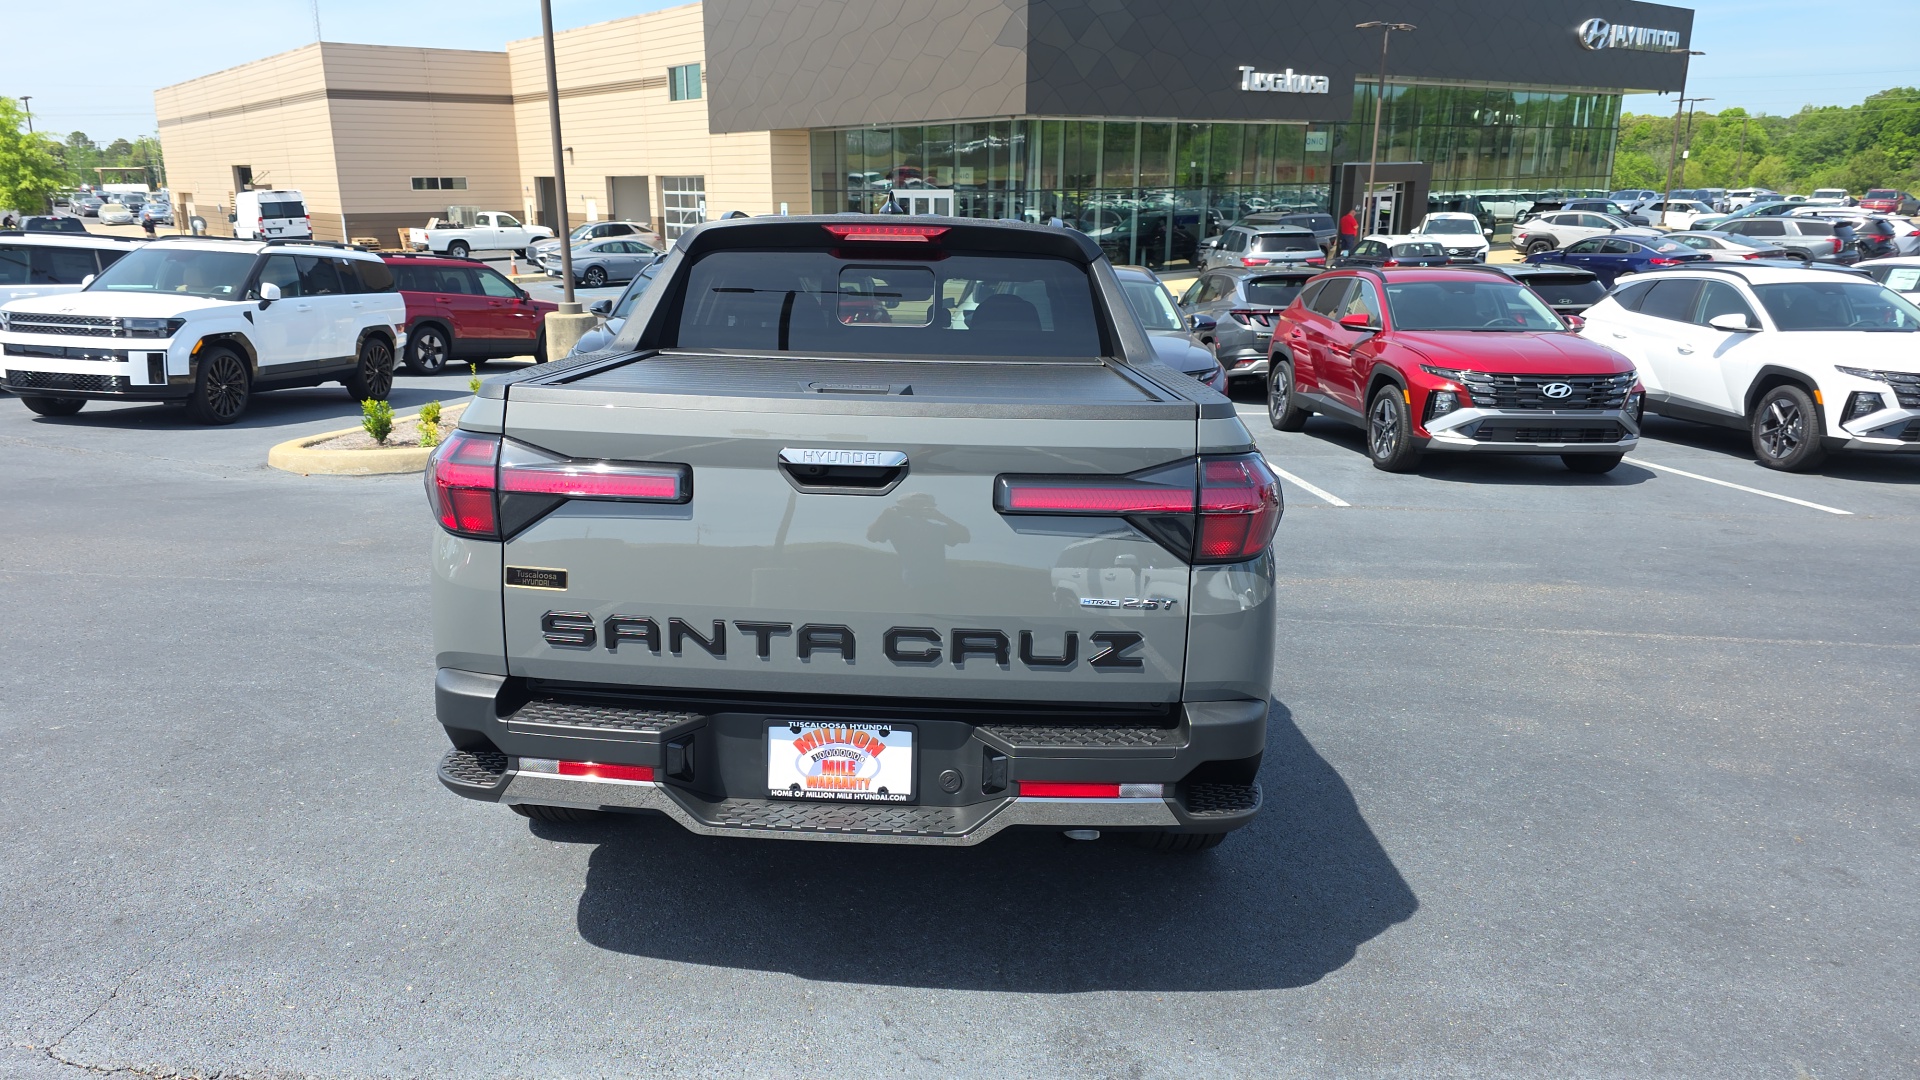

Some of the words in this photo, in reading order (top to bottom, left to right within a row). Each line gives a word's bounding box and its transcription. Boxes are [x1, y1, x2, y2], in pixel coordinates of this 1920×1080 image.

[1610, 24, 1680, 49] HYUNDAI
[1238, 66, 1330, 93] Tuscaloosa
[803, 450, 882, 464] HYUNDAI
[516, 570, 557, 580] Tuscaloosa
[522, 578, 550, 586] HYUNDAI
[1081, 598, 1120, 606] HTRAC
[540, 609, 857, 664] SANTA
[882, 625, 1146, 673] CRUZ
[788, 721, 847, 730] TUSCALOOSA
[850, 723, 892, 731] HYUNDAI
[793, 728, 886, 758] MILLION
[821, 759, 856, 777] MILE
[805, 775, 872, 791] WARRANTY
[771, 789, 793, 798] HOME
[806, 791, 835, 799] MILLION
[854, 793, 907, 802] HYUNDAI.COM
